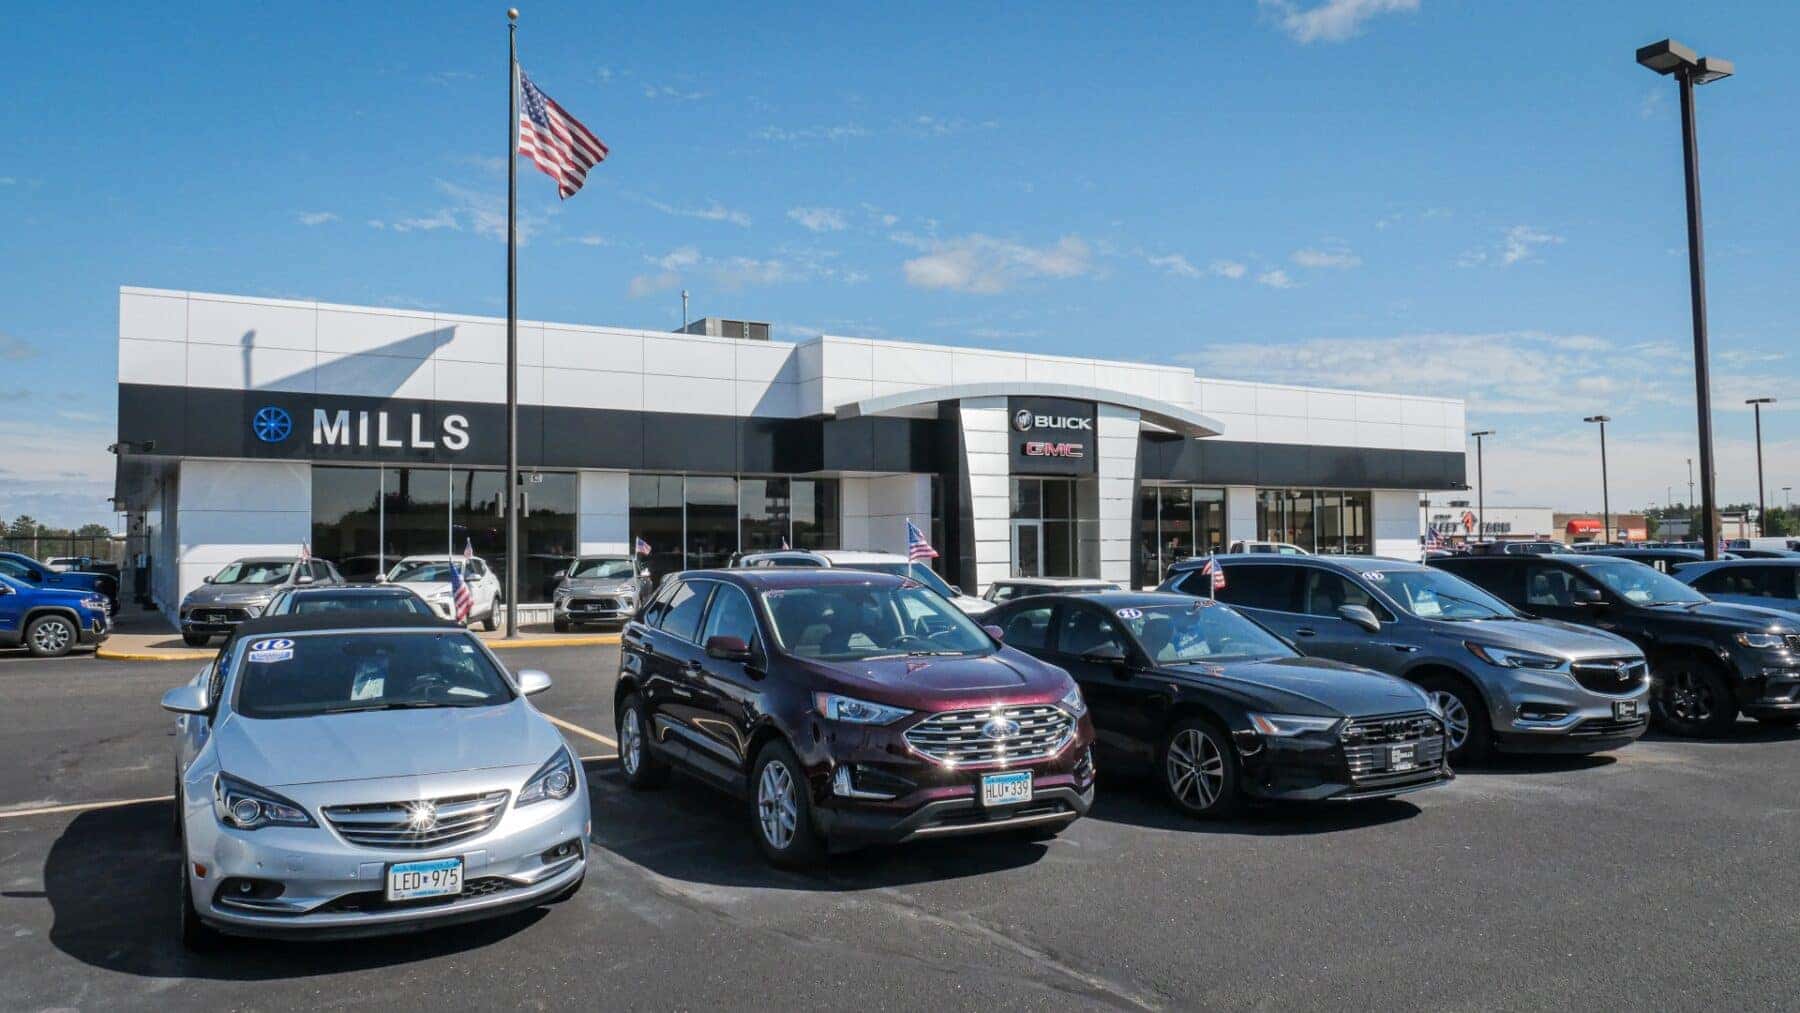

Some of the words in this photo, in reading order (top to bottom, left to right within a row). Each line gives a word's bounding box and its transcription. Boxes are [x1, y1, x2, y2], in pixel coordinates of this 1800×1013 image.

[312, 408, 470, 450] MILLS
[1034, 415, 1093, 430] BUICK
[1025, 441, 1084, 458] GMC
[1011, 780, 1029, 796] 339
[394, 872, 421, 891] LED
[432, 868, 458, 887] 975
